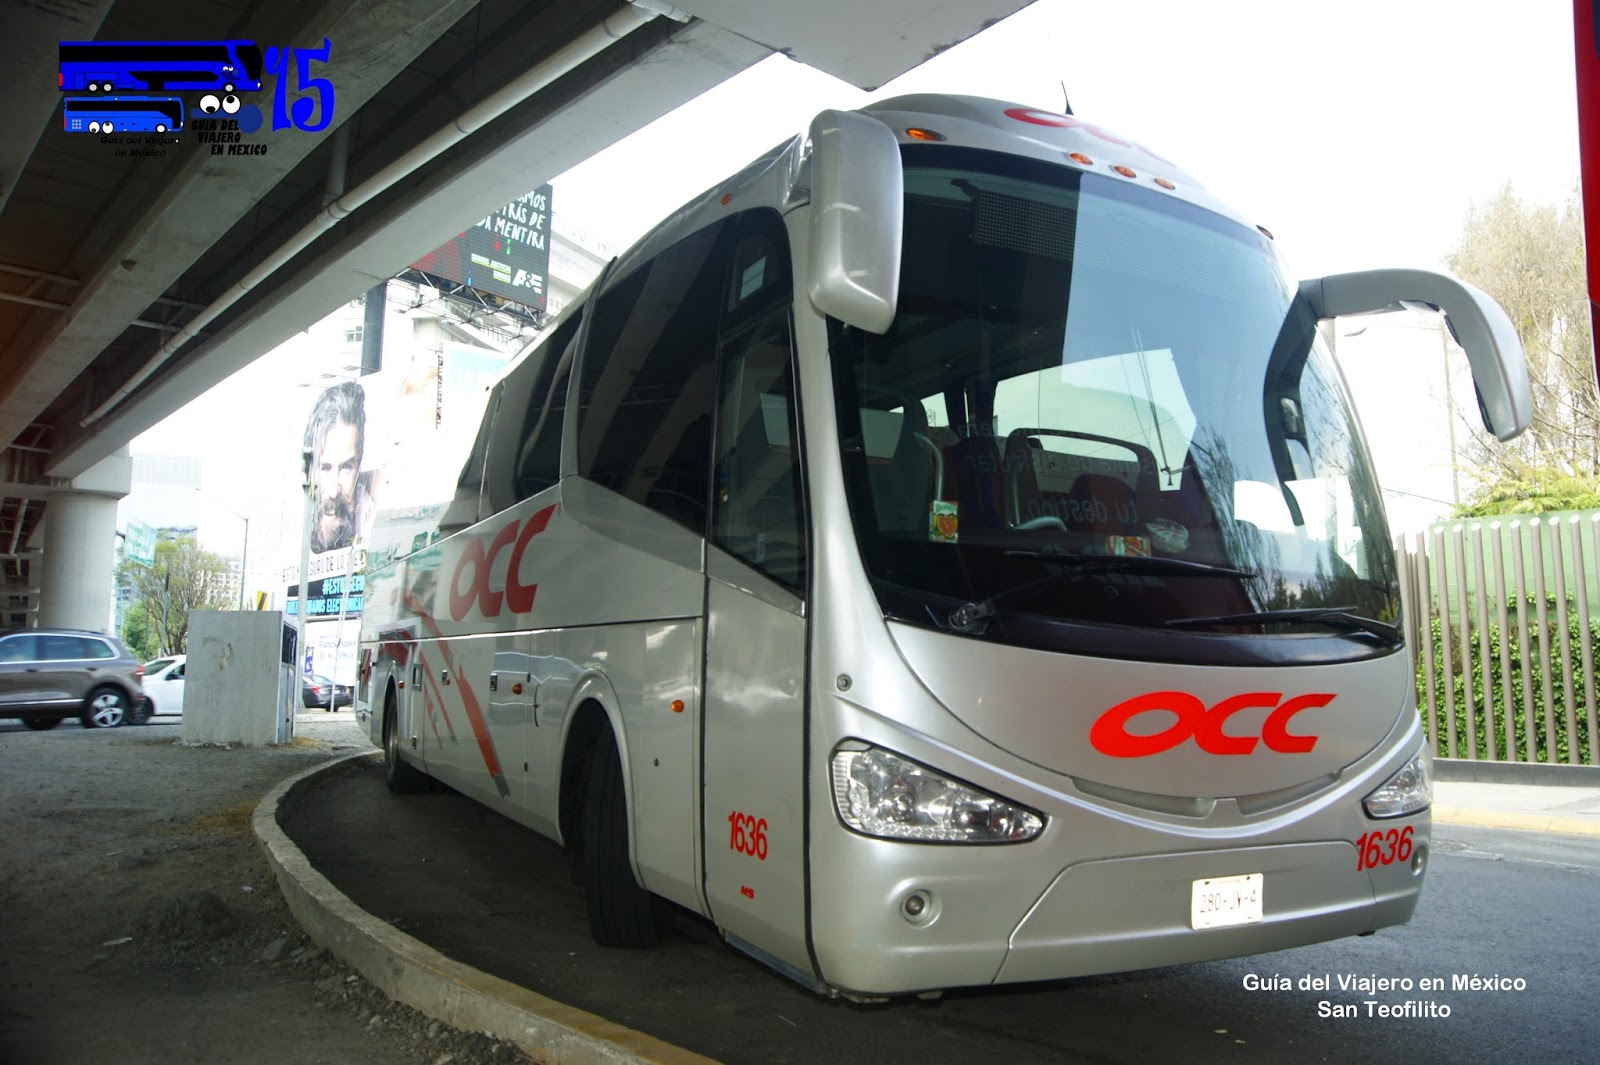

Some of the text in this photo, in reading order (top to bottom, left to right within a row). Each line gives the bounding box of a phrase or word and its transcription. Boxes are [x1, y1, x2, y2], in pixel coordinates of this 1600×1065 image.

[494, 216, 545, 251] MENTIRA
[528, 211, 546, 230] DE
[512, 268, 543, 295] A&E
[449, 503, 557, 622] OCC
[1088, 690, 1337, 759] OCC
[728, 810, 768, 861] 1636
[1356, 825, 1414, 872] 1636
